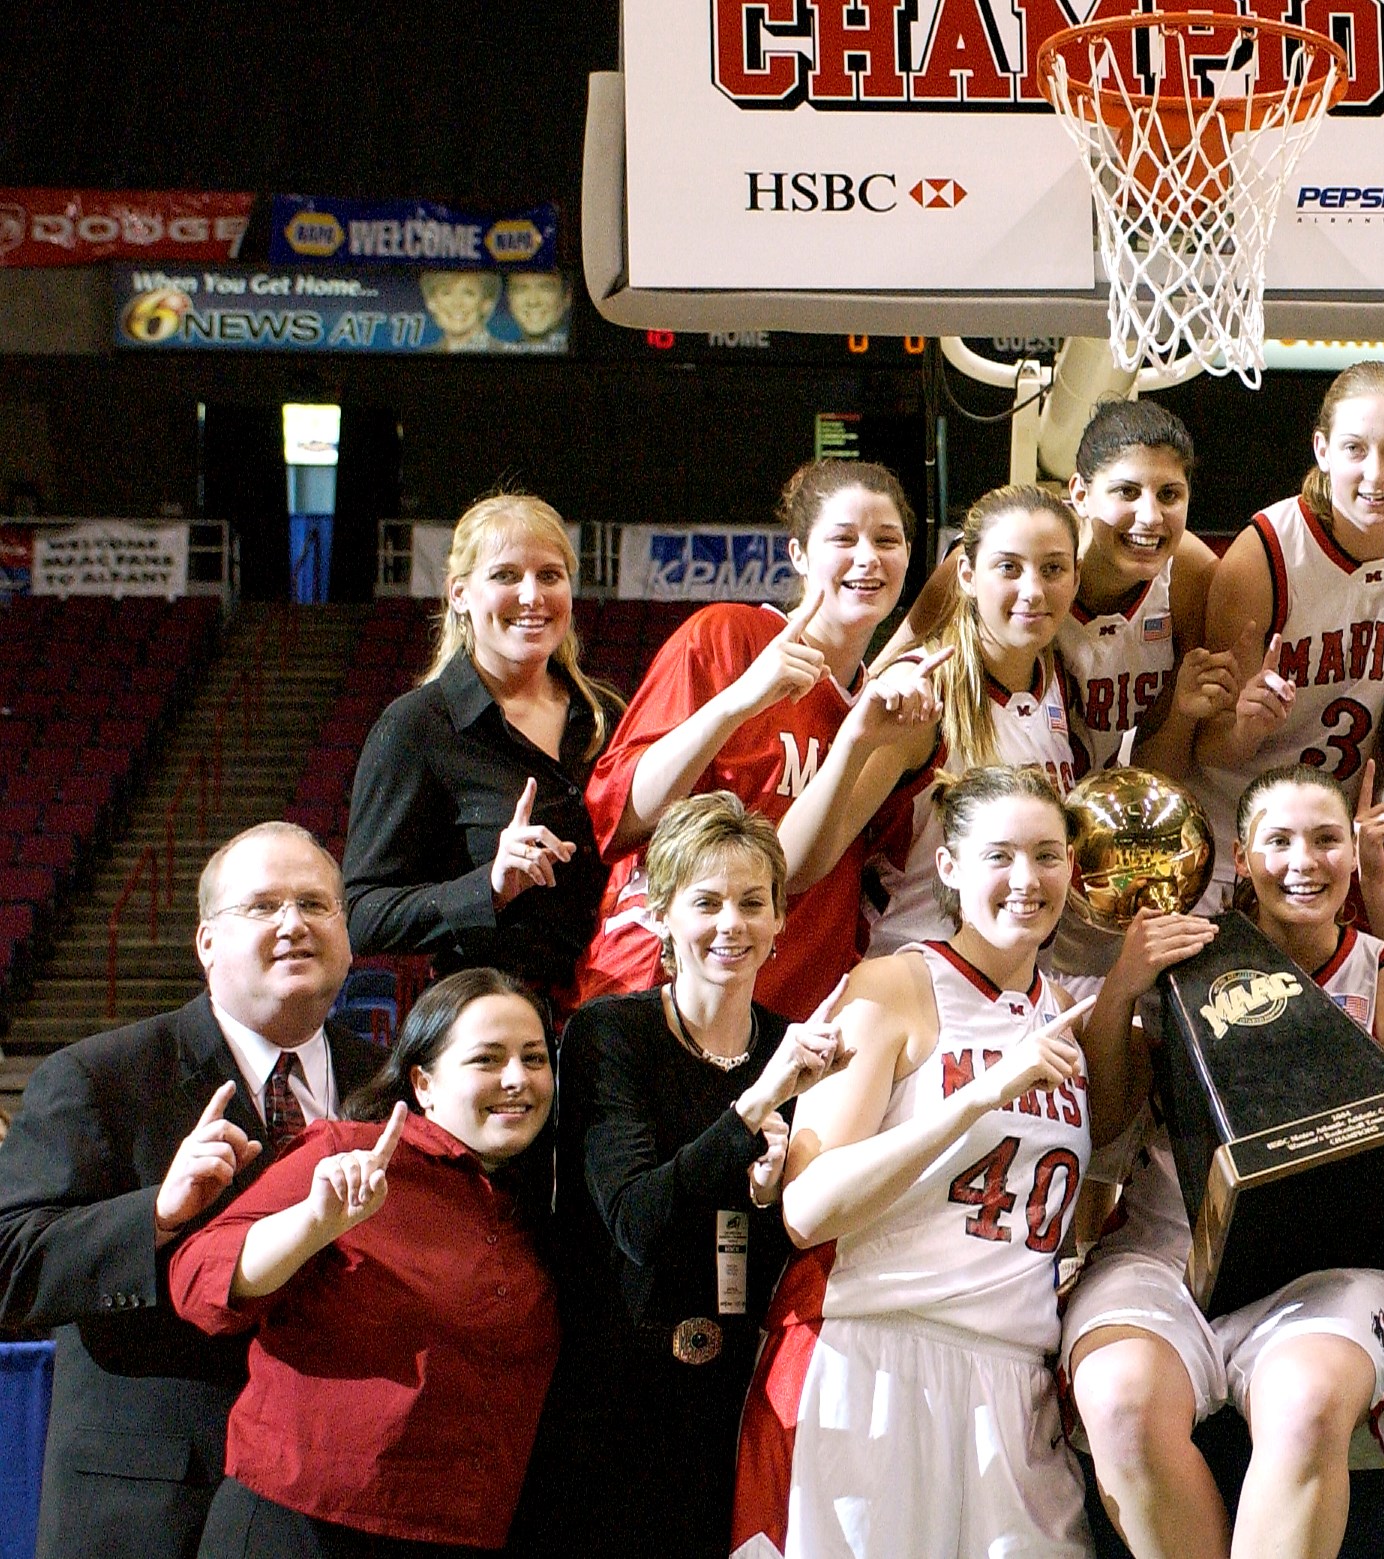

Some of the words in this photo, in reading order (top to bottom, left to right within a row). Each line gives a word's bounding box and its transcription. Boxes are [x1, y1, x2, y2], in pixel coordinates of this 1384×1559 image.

[744, 171, 898, 213] HSBC
[350, 219, 482, 260] WELCOME
[132, 271, 198, 292] When
[204, 273, 247, 294] You
[250, 274, 290, 296] Get
[183, 309, 323, 344] NEWS
[328, 311, 388, 347] AT
[390, 312, 426, 347] 11
[645, 560, 797, 598] KPMG
[1300, 697, 1373, 782] 3
[1200, 971, 1304, 1039] MAAC
[948, 1135, 1080, 1254] 40
